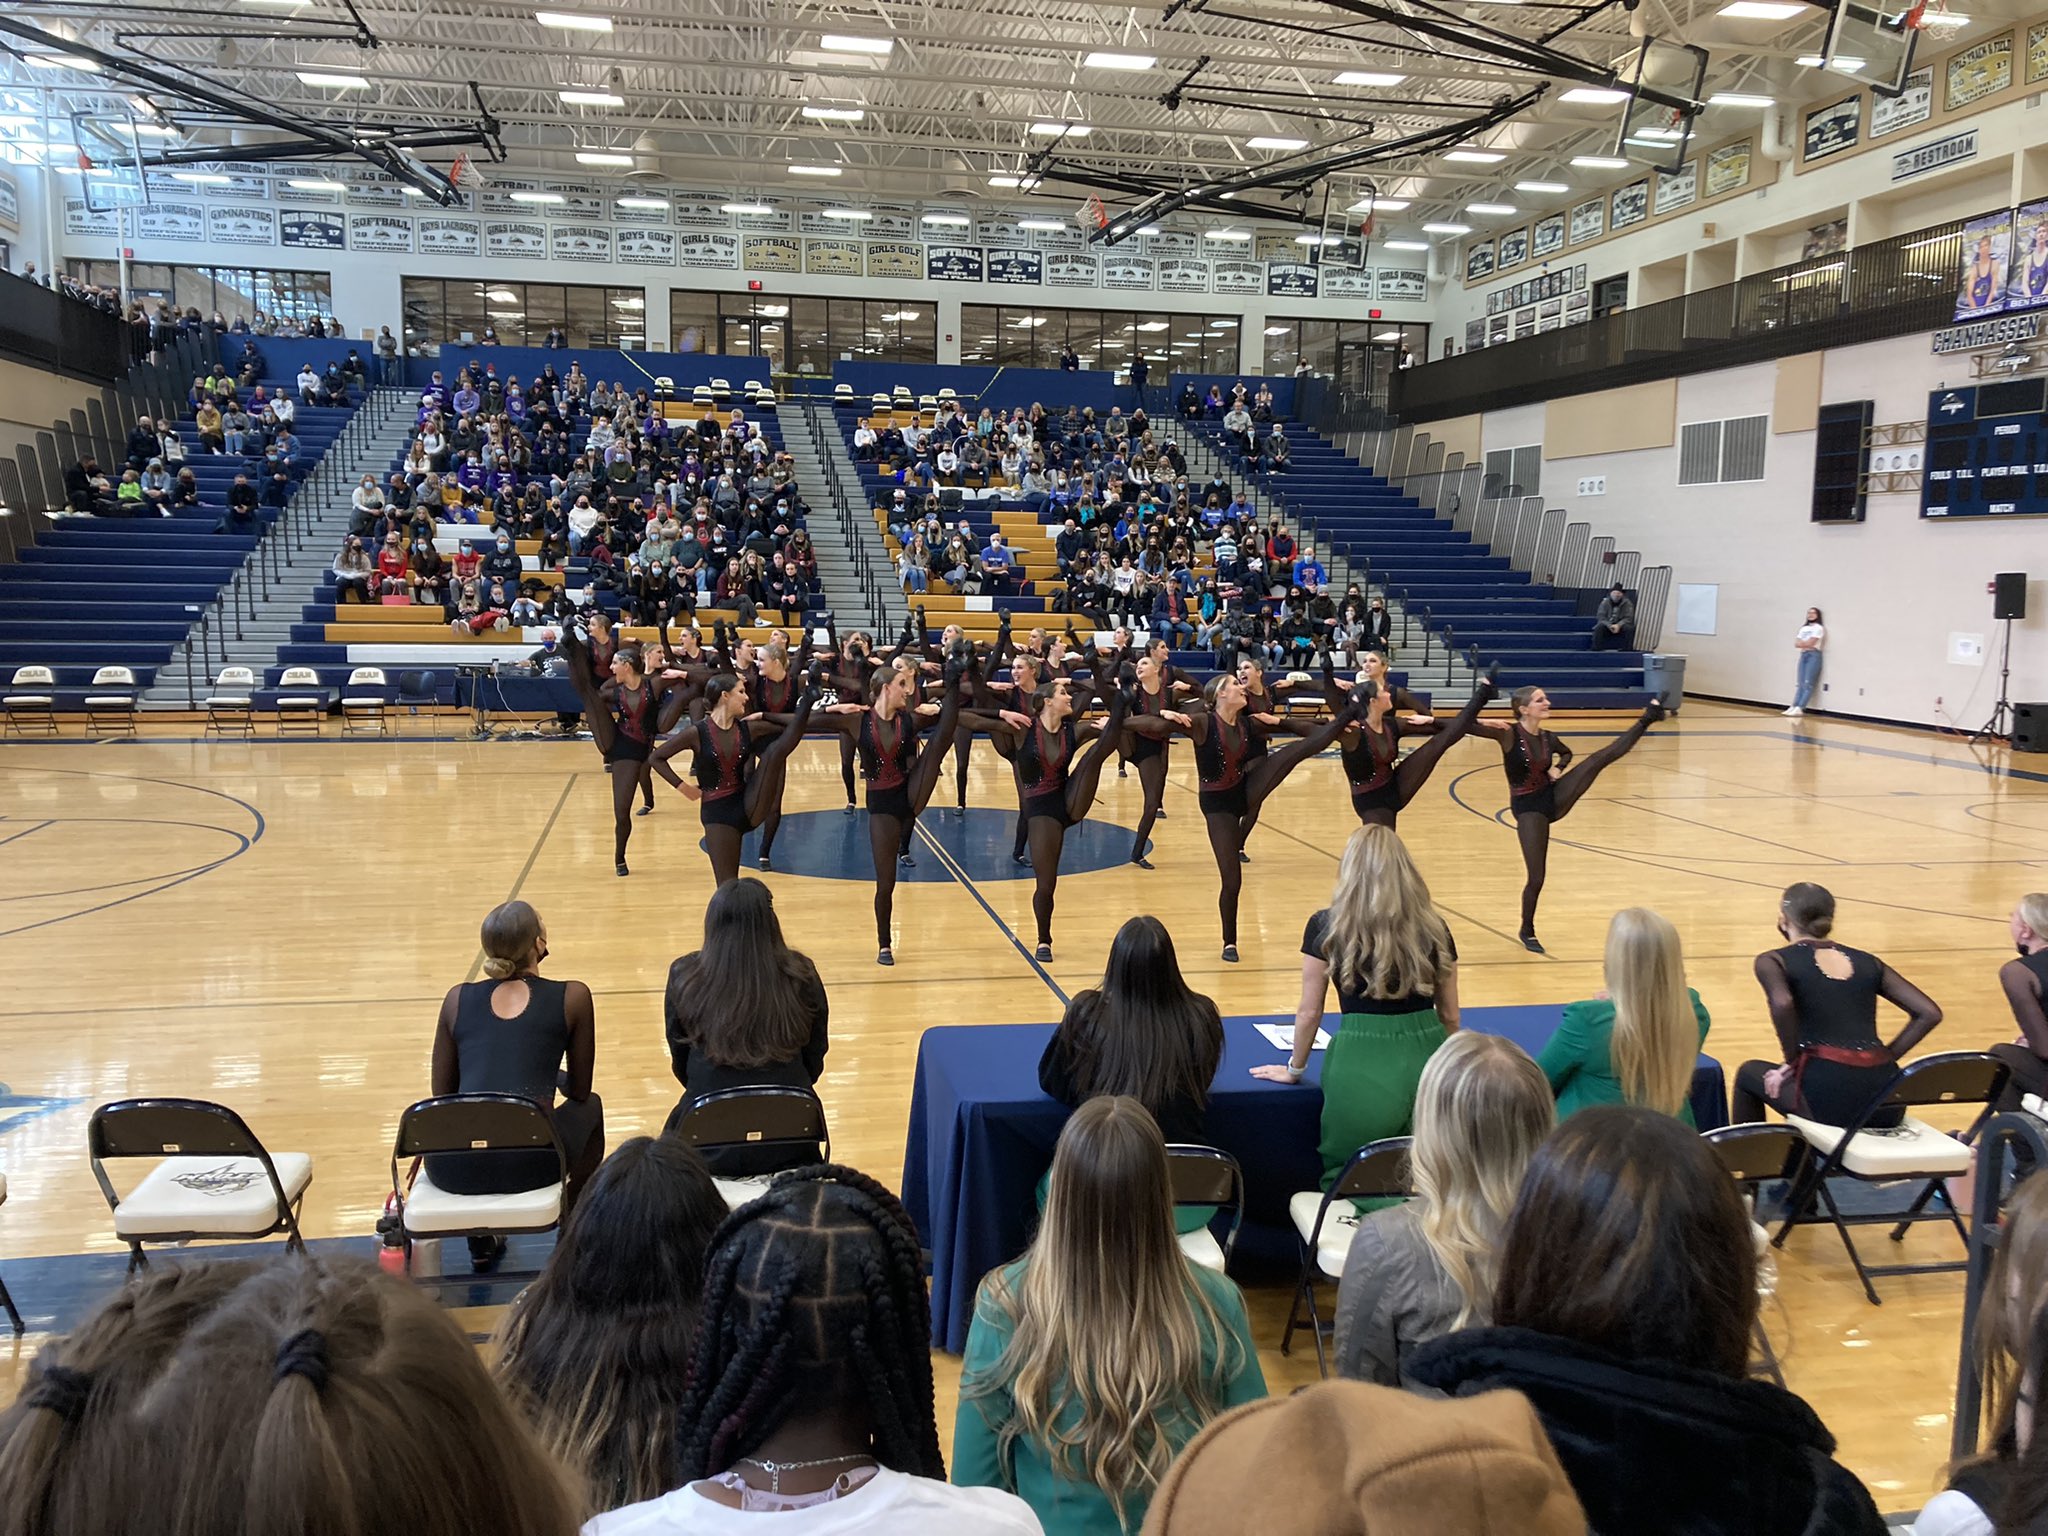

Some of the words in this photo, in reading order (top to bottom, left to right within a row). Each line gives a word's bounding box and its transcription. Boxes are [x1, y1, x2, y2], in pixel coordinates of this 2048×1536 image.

[1914, 136, 1974, 169] RESTROOM
[210, 208, 272, 223] GYMNASTICS
[352, 218, 411, 230] SOFTBALL
[420, 220, 440, 232] BOYS
[441, 220, 478, 234] LACROSSE
[488, 224, 508, 235] GIRLS
[510, 224, 544, 238] LACROSSE
[618, 231, 644, 242] BOYS
[648, 231, 674, 244] GOLF
[682, 234, 710, 246] GIRLS
[712, 234, 736, 248] GOLF
[746, 238, 798, 250] SOFTBALL
[869, 245, 896, 255] GIRLS
[899, 245, 922, 257] GOLF
[930, 248, 982, 261] SOFTBALL
[990, 250, 1016, 261] GIRLS
[1018, 251, 1040, 264] GOLF
[1048, 255, 1068, 265] GIRLS
[1070, 254, 1096, 268] SOCCER
[1160, 260, 1179, 270] BOYS
[1181, 260, 1208, 274] SOCCER
[1325, 268, 1372, 280] GYMNASTICS
[1380, 271, 1398, 280] GIRLS
[1400, 272, 1426, 282] HOCKEY
[1933, 314, 2040, 352] CHANHASSEN
[1994, 424, 2020, 435] PERIOD
[1930, 470, 1952, 480] FOULS
[1981, 466, 2008, 477] PLAYER
[2010, 465, 2029, 475] FOUL
[1926, 506, 1948, 516] SCORE
[1988, 504, 2016, 513] MATCH
